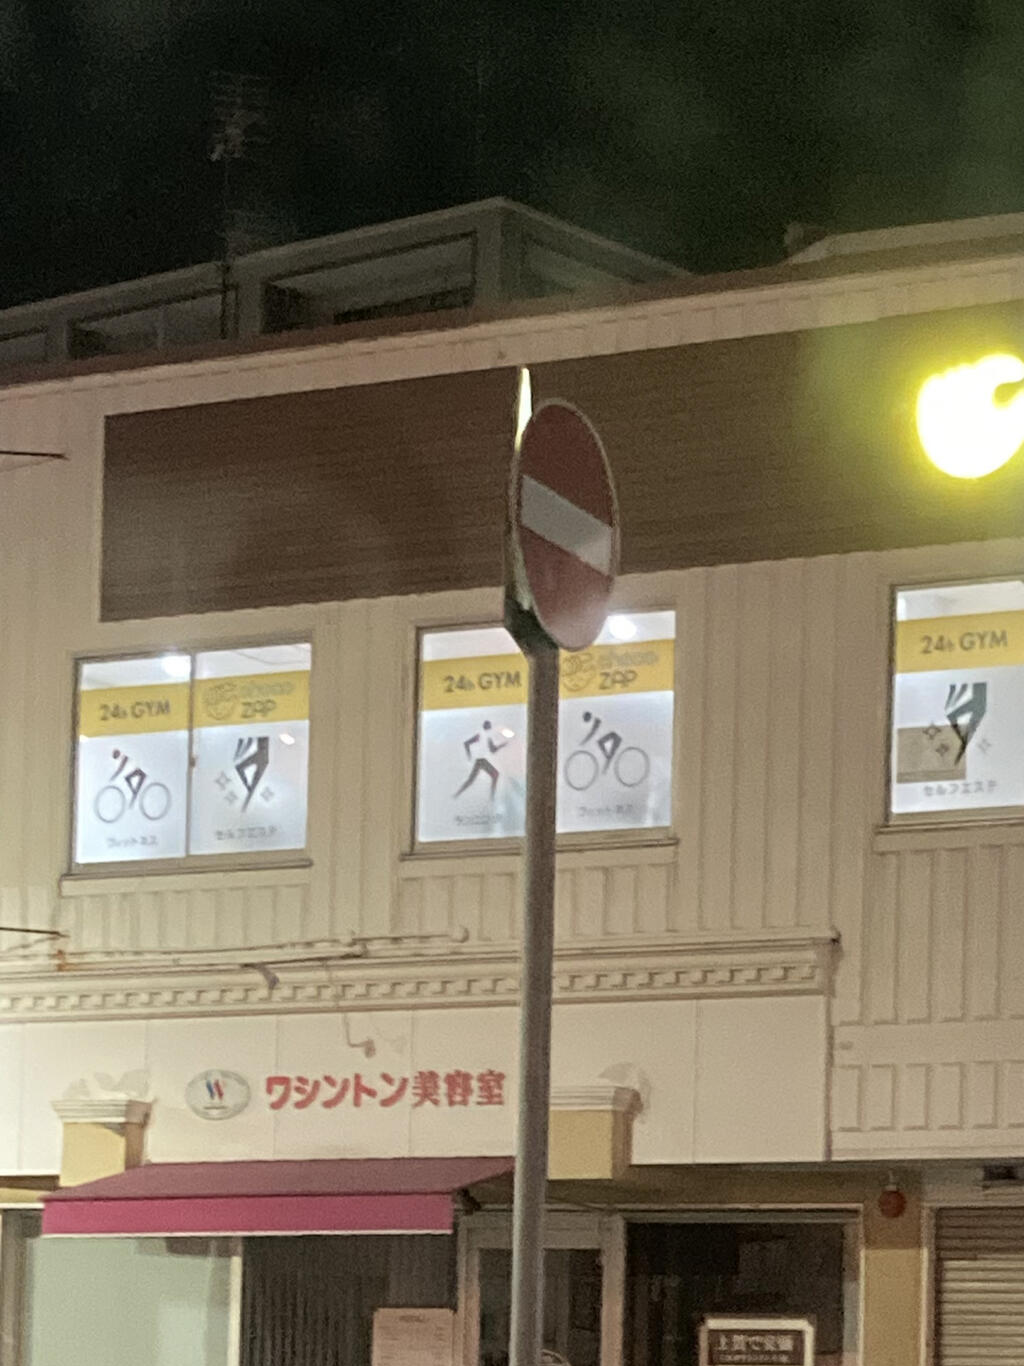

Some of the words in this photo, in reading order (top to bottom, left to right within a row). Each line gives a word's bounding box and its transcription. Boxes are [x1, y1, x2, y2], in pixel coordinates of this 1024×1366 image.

[959, 630, 1008, 651] GYM
[478, 671, 522, 691] GYM
[131, 700, 171, 719] GYM
[922, 780, 998, 797] セルフエステ
[265, 1069, 506, 1110] ワシントン美容室
